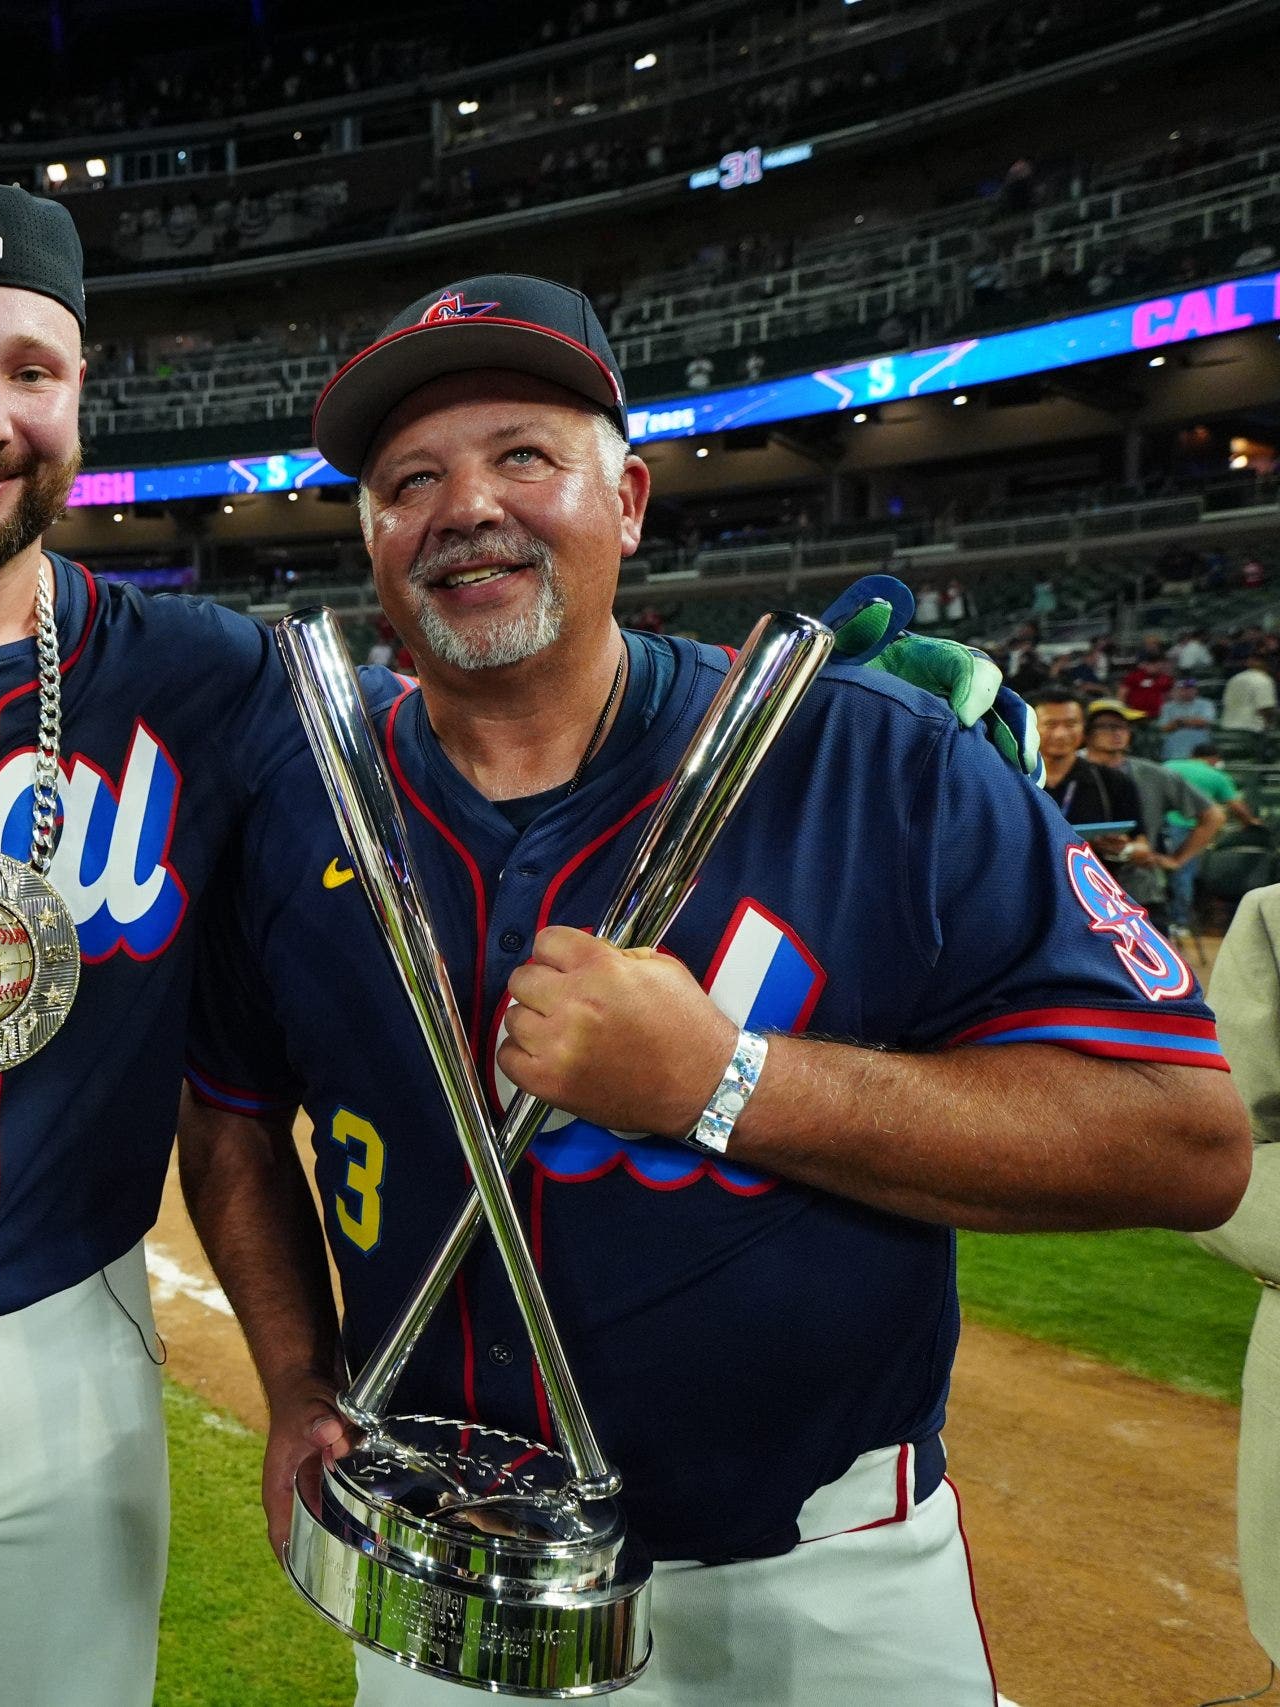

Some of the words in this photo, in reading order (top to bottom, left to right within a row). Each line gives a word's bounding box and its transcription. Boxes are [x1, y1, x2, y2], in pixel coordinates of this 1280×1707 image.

[719, 146, 763, 189] 31
[1132, 283, 1253, 349] CAL
[331, 1106, 388, 1256] 3
